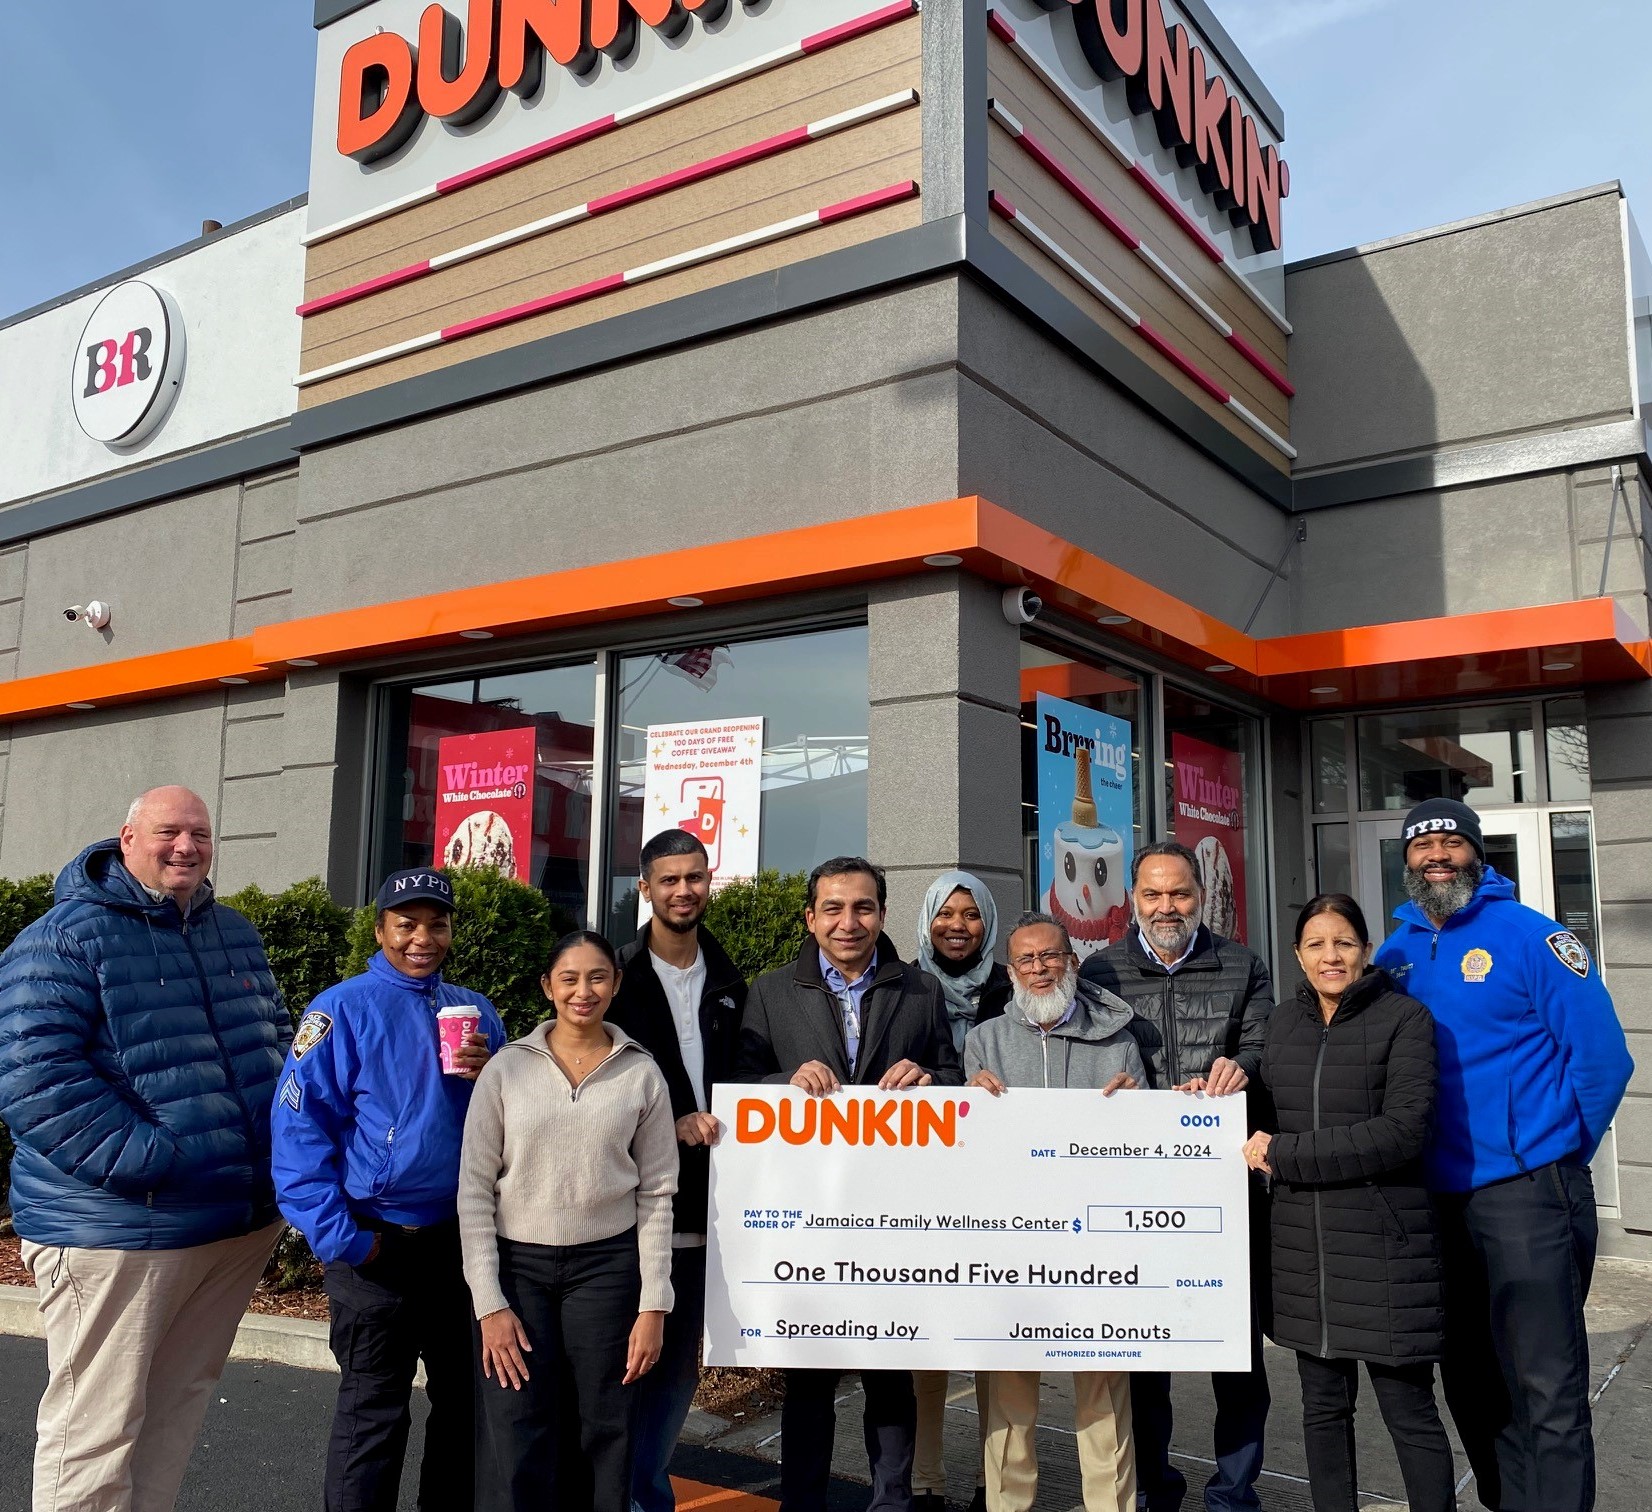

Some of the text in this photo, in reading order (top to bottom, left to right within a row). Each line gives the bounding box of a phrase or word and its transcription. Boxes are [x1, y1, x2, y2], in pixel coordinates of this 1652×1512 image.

[1066, 0, 1290, 251] UNKIN'
[650, 723, 760, 738] CELEBRATE OUR GRAND REOPENING
[674, 735, 734, 747] 100 DAYS OF FREE
[701, 746, 737, 755] GIVEAWAY
[1044, 714, 1127, 781] Brrring
[653, 758, 754, 771] Wednesday, December 4th
[443, 761, 529, 791] Winter
[1101, 777, 1123, 790] the cheer
[1176, 761, 1240, 810] Winter
[442, 789, 512, 803] White Chocolate
[701, 813, 715, 831] D
[1178, 801, 1230, 827] White Chocolate
[1405, 818, 1458, 840] NYPD
[393, 873, 450, 895] NYPD
[736, 1097, 971, 1148] DUNKIN'
[1180, 1114, 1220, 1128] 0001
[1031, 1142, 1212, 1159] DATE December 4, 2024
[743, 1209, 803, 1220] PAY TO THE
[743, 1210, 1186, 1234] ORDER OF Jamaica Family Wellness Center $ 1,500
[773, 1260, 1223, 1288] One Thousand Five Hundred DOLLARS
[740, 1318, 1172, 1342] FOR Spreading Joy Jamaica Donuts
[1045, 1350, 1142, 1358] AUTHORIZED SIGNATURE
